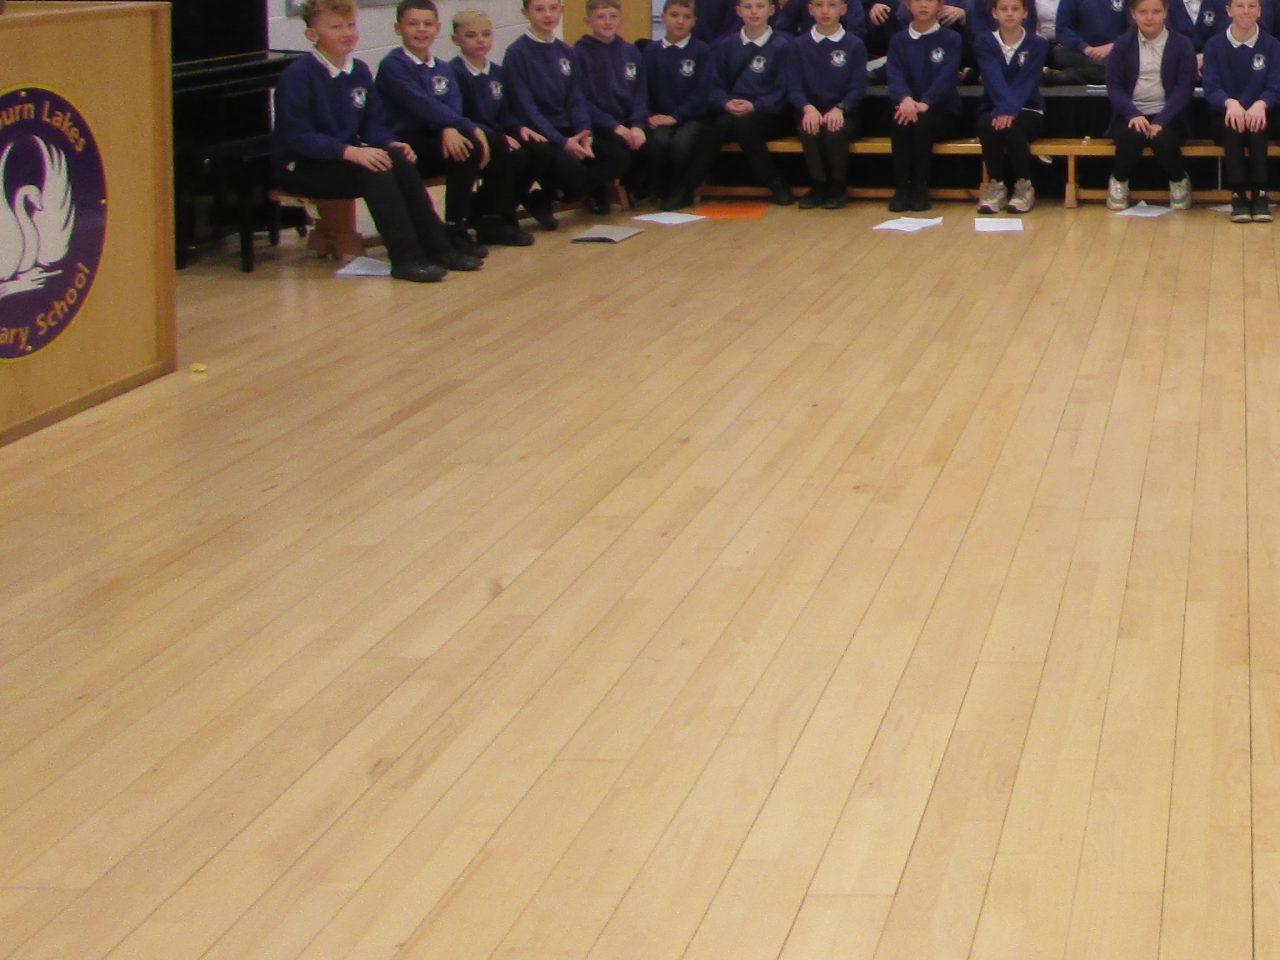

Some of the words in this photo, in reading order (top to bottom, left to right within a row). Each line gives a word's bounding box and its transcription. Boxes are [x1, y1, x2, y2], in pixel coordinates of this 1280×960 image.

[0, 102, 35, 131] urn
[41, 100, 87, 152] Lakes
[0, 326, 29, 350] ary
[35, 262, 90, 336] School
